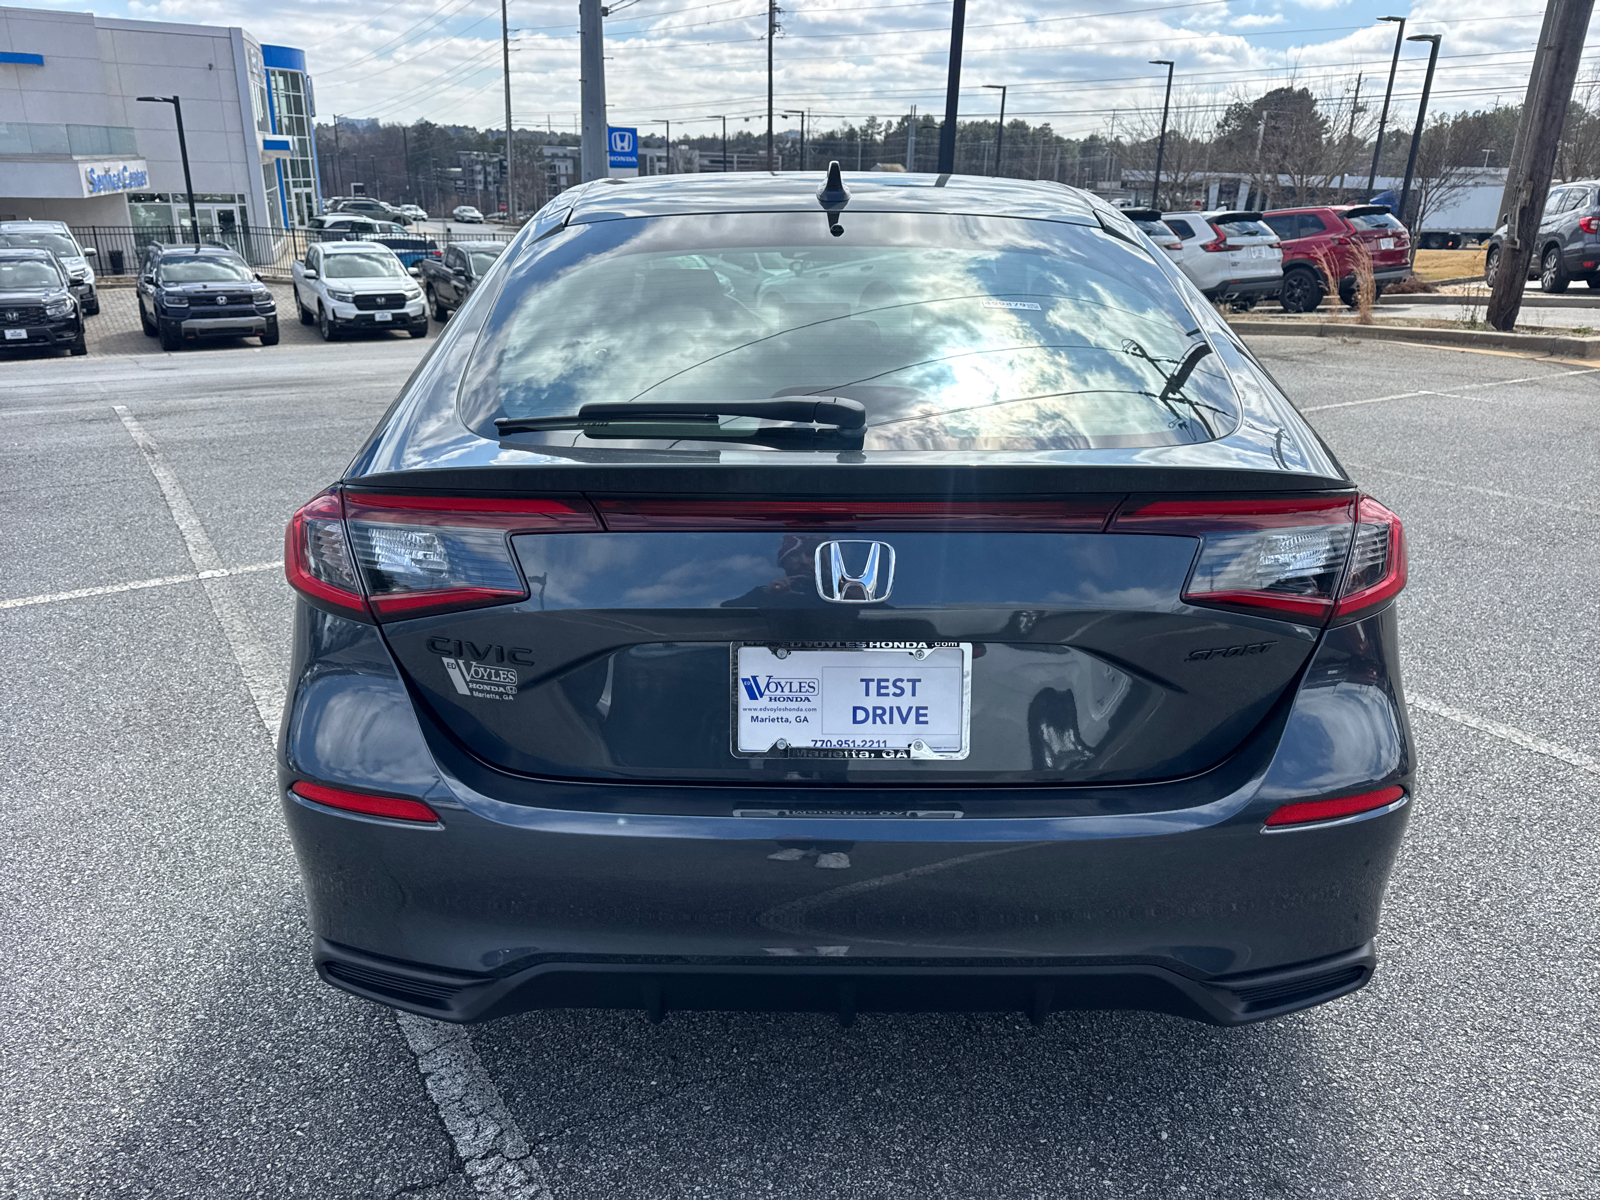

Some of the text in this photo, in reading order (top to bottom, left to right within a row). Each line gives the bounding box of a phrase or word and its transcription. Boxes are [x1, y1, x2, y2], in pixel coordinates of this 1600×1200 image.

[86, 165, 147, 193] Service Center
[426, 636, 535, 666] CIVIC
[1184, 640, 1279, 662] SPORT
[446, 659, 516, 684] ED VOYLES
[468, 682, 507, 692] HONDA
[473, 691, 502, 700] Marietta,
[750, 675, 816, 699] VOYLES
[860, 678, 921, 697] TEST
[750, 715, 792, 724] Marietta,
[852, 706, 929, 724] DRIVE
[811, 739, 887, 748] 770-951-2211
[792, 749, 908, 758] Marietta, GA
